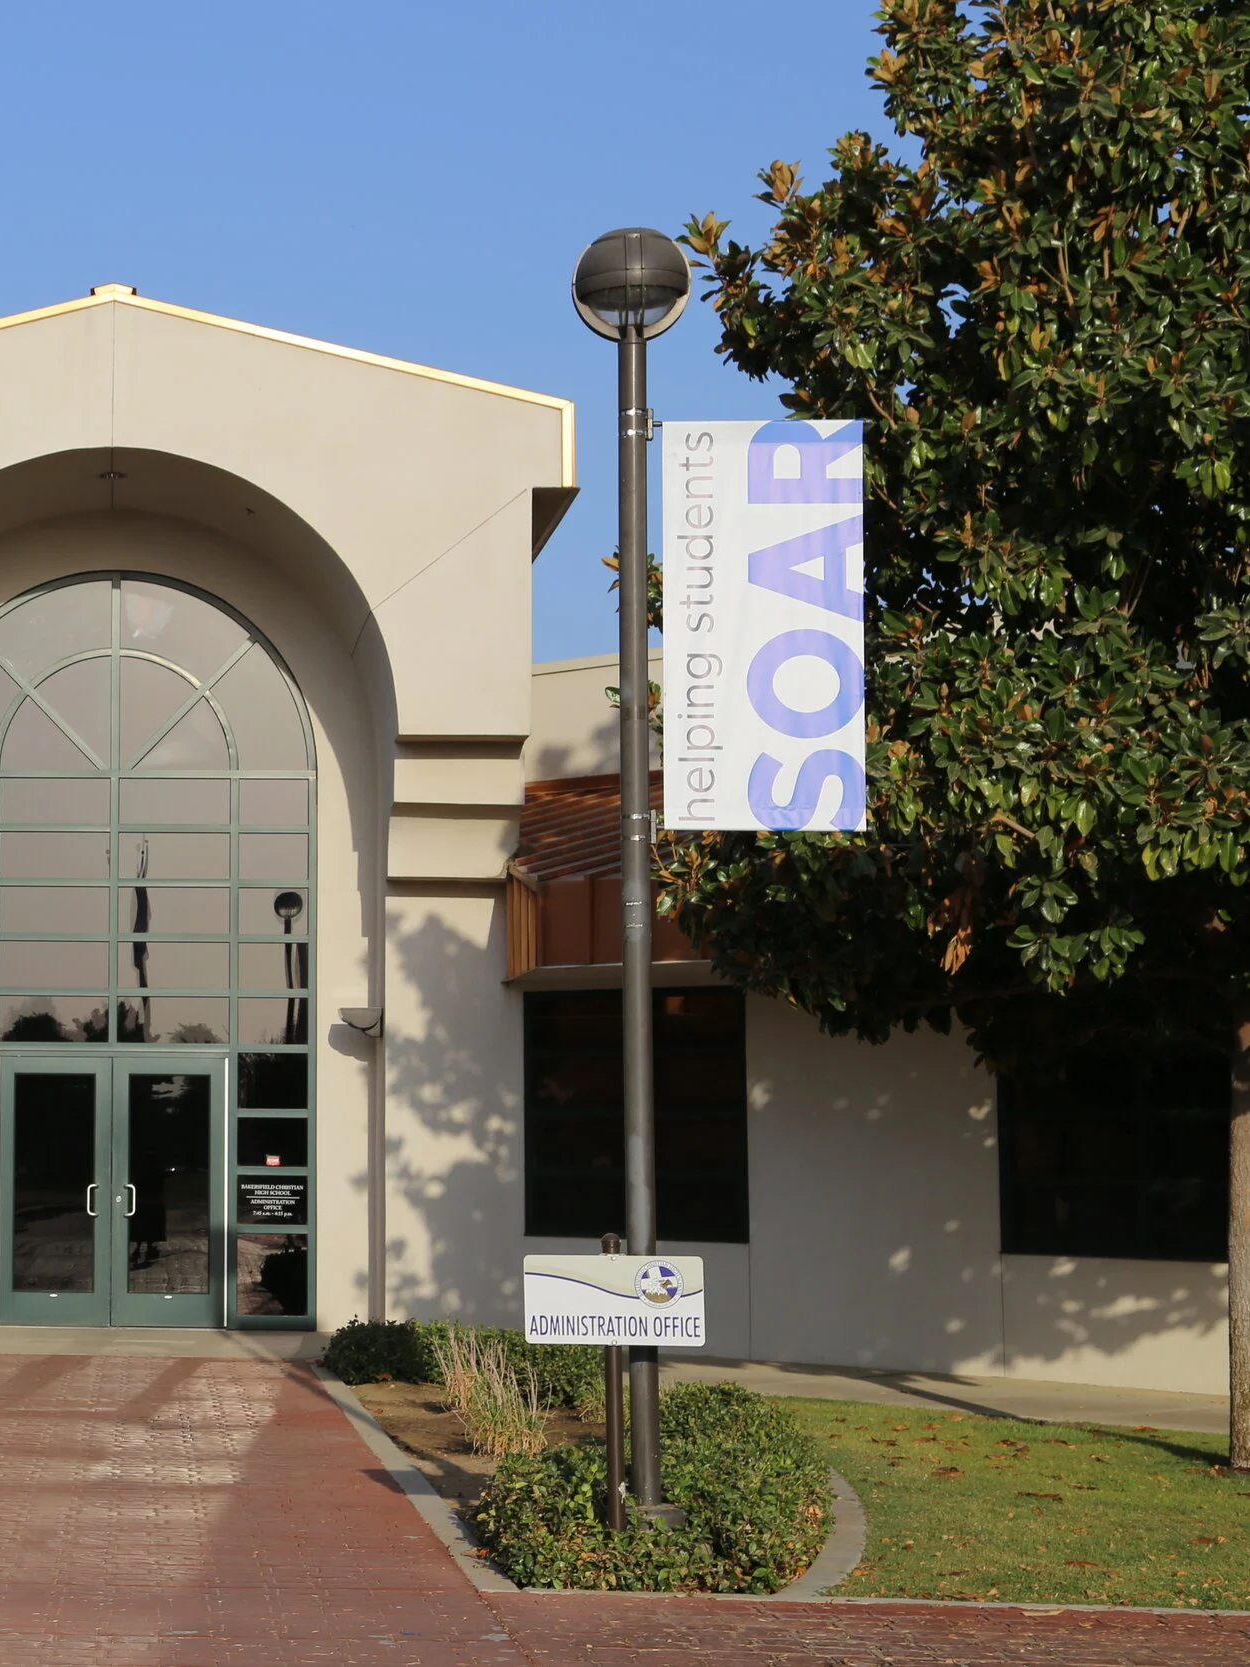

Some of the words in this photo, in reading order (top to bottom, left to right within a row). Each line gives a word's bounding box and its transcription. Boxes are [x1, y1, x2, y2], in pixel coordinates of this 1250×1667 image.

[677, 430, 715, 633] students
[746, 419, 866, 832] SOAR
[677, 652, 723, 822] helping
[529, 1315, 648, 1337] ADMINISTRATION
[653, 1316, 701, 1338] OFFICE
